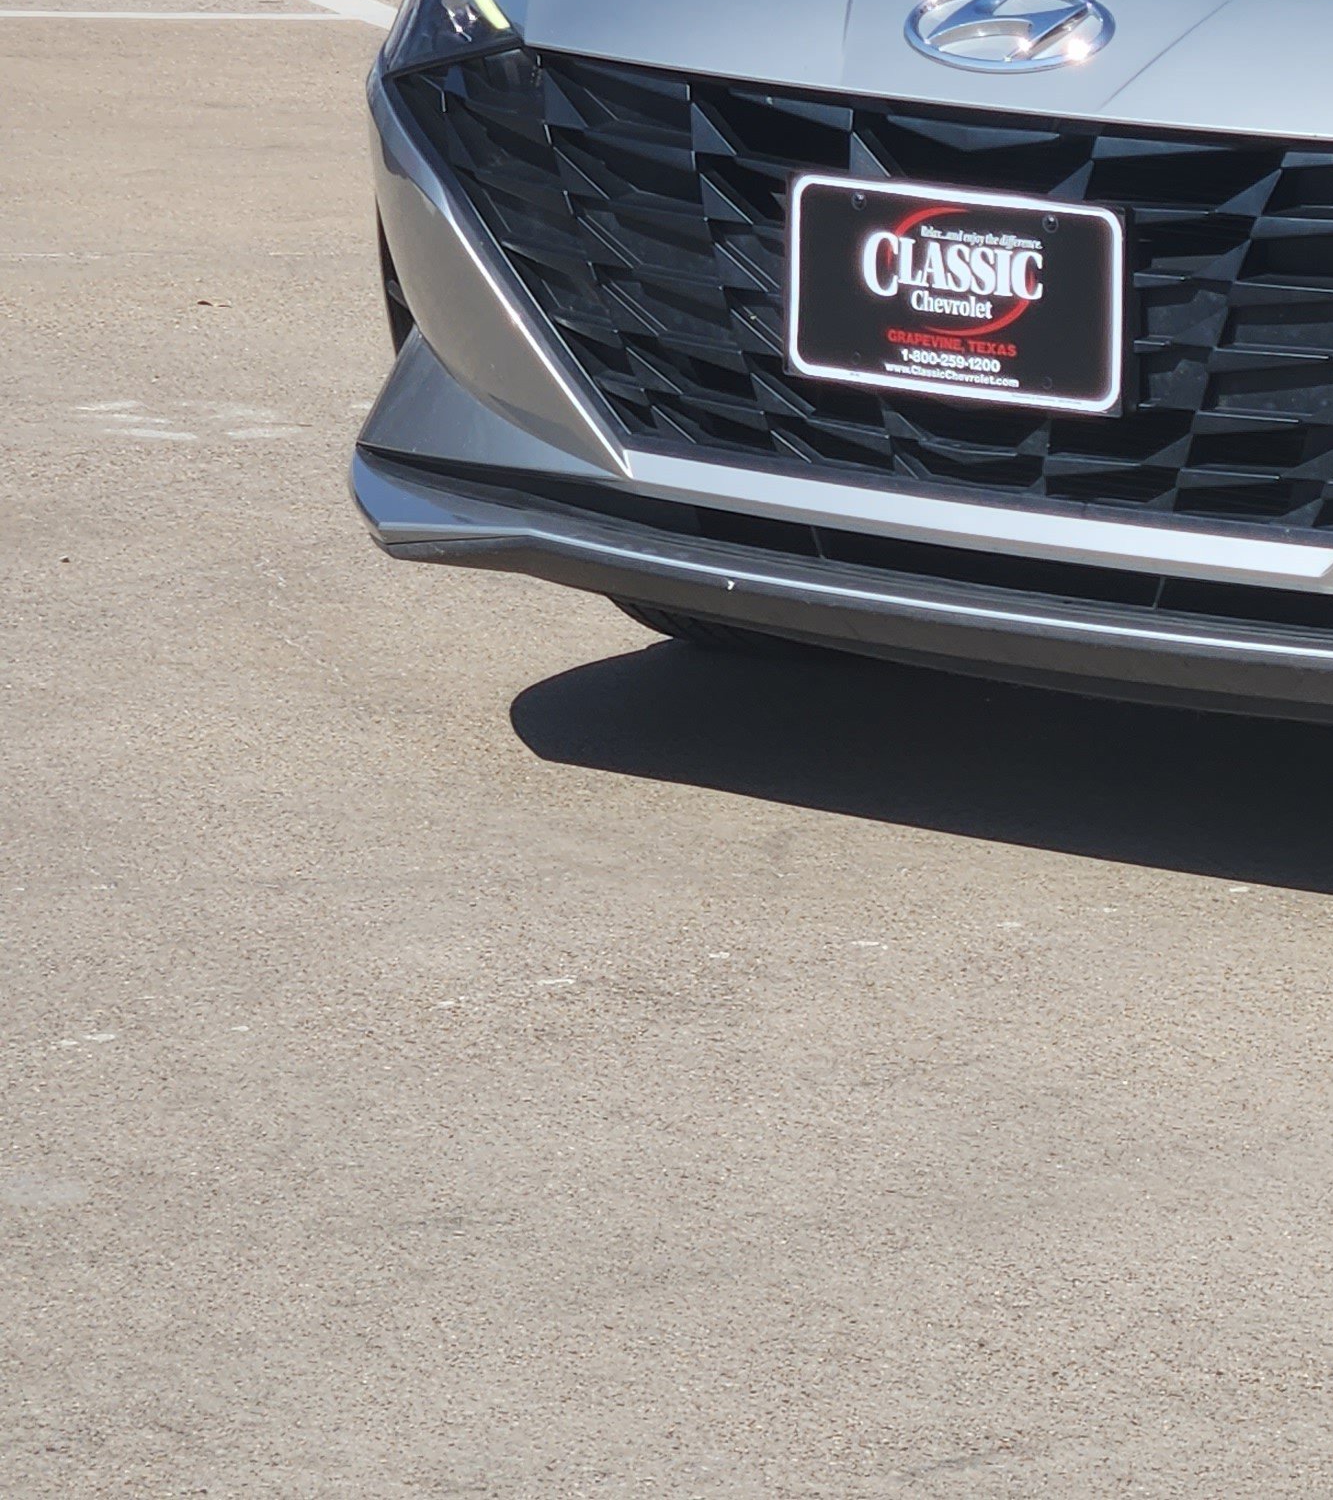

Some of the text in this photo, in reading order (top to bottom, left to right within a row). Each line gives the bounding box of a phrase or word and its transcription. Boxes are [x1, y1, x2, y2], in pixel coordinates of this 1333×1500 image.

[862, 231, 1044, 301] CLASSIC
[910, 290, 993, 320] Chevrolet
[888, 329, 1017, 357] GRAPEVINE, TEXAS
[901, 348, 1001, 373] 1-800-259-1200
[884, 362, 1020, 388] www.ClassicChevrolet.com
